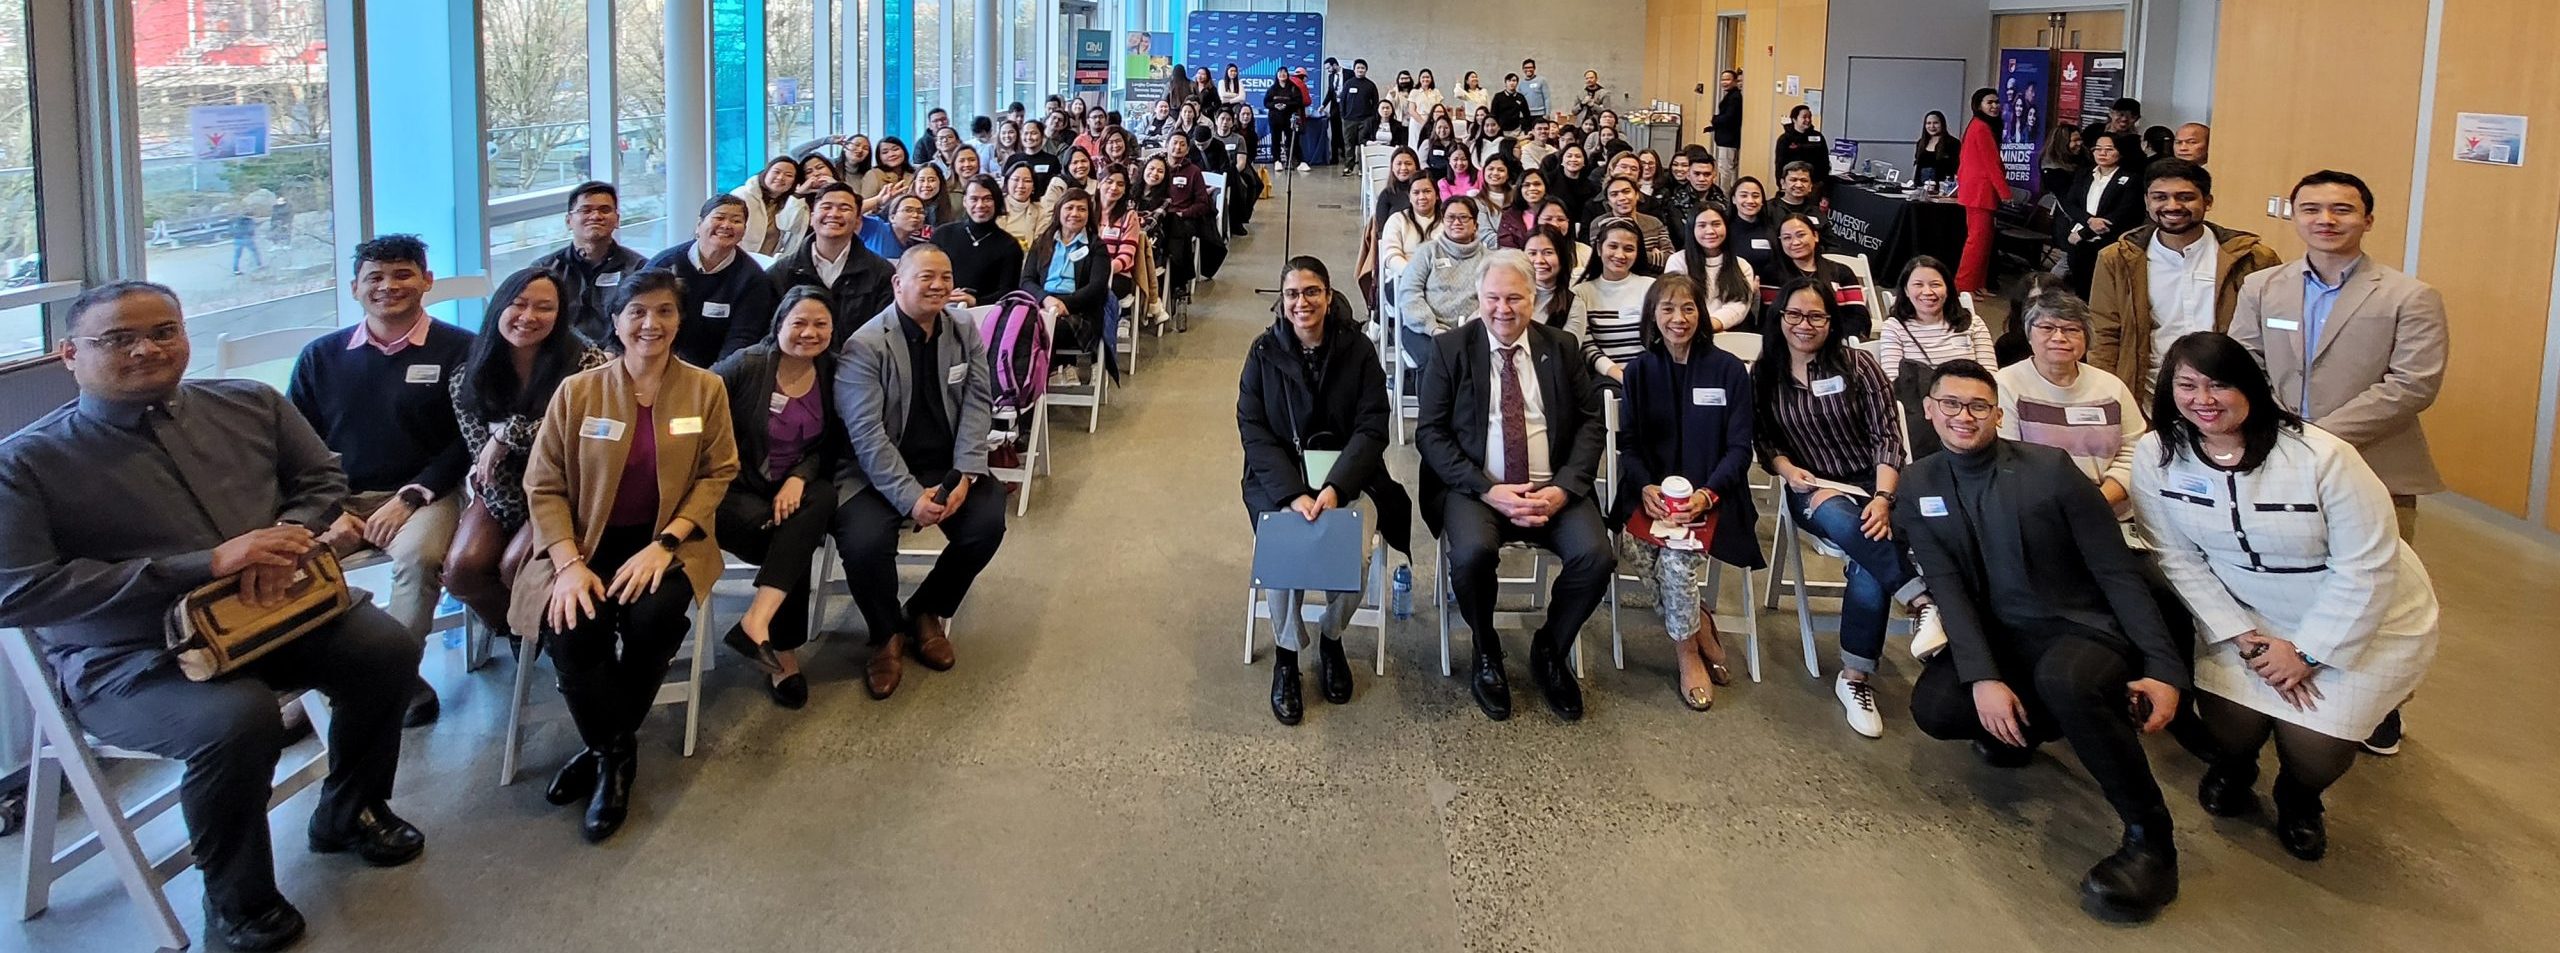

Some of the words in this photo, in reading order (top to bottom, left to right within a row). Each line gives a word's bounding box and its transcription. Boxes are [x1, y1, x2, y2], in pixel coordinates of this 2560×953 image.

[1240, 78, 1275, 88] CSEND
[2000, 150, 2031, 163] MINDS
[2005, 171, 2030, 181] ADERS
[1827, 208, 1870, 234] UNIVERSITY
[1858, 233, 1884, 251] WEST
